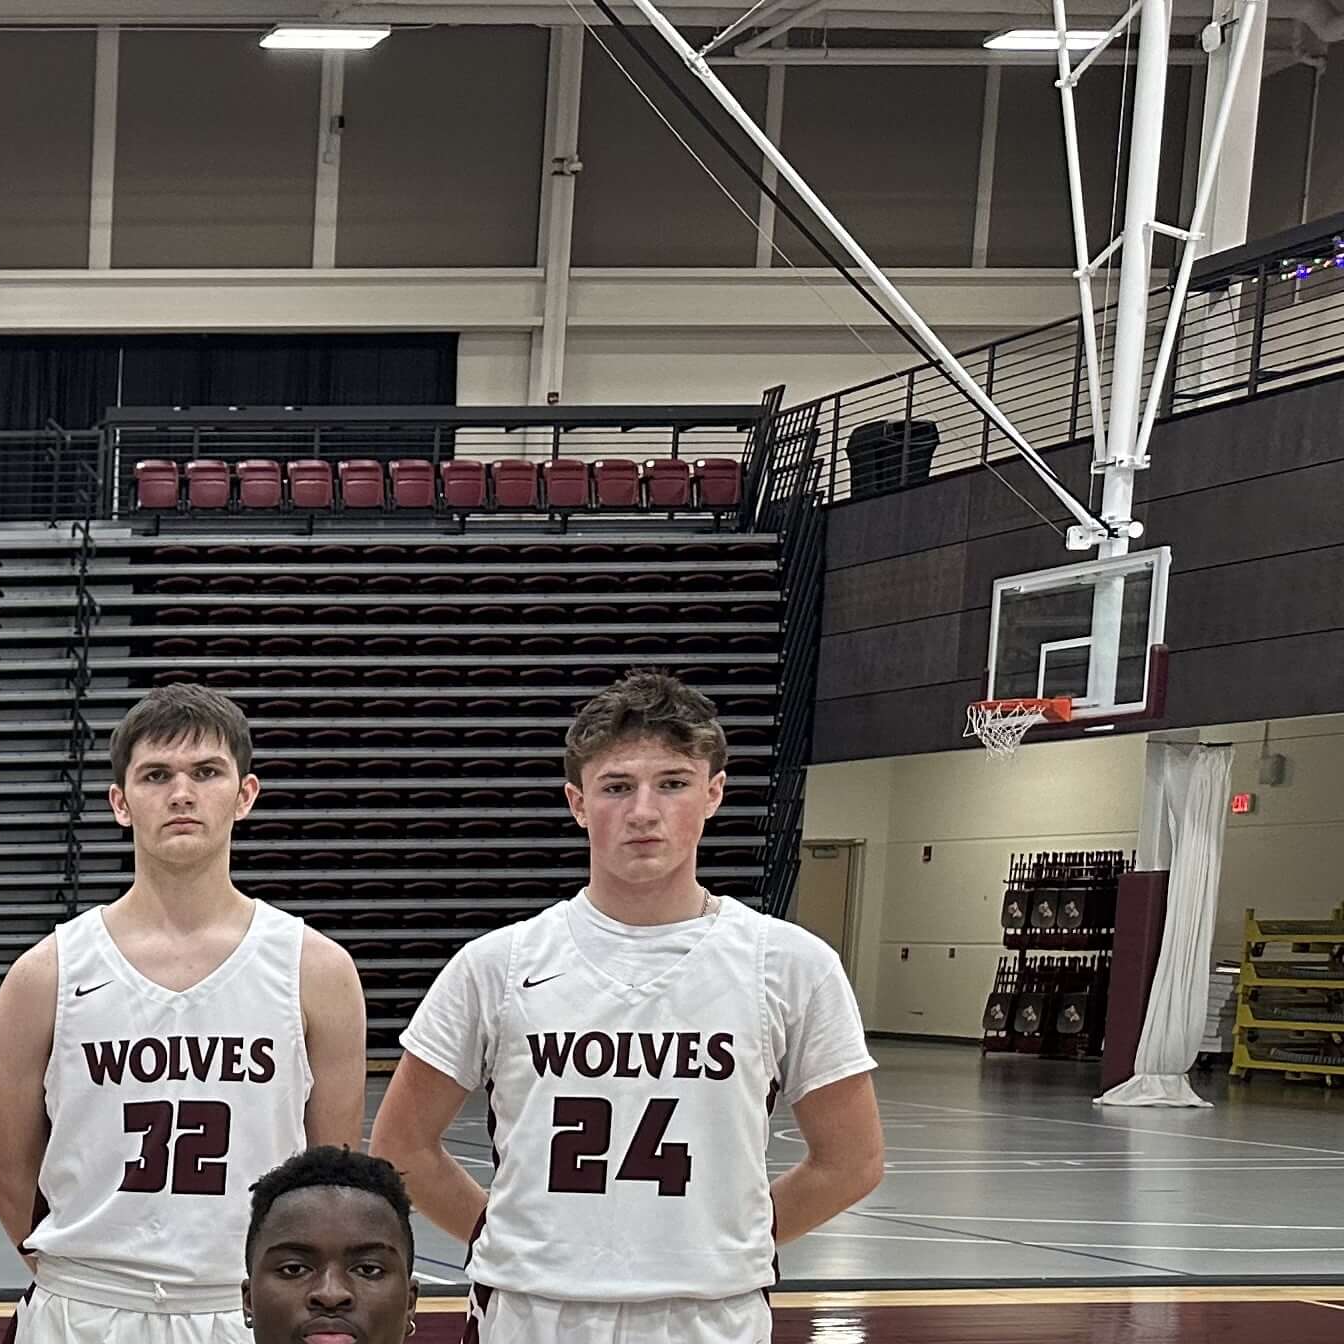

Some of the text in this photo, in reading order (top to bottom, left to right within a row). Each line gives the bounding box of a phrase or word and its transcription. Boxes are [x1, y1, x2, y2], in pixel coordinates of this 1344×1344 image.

[80, 1035, 276, 1087] WOLVES
[525, 1031, 736, 1081] WOLVES
[116, 1099, 232, 1196] 32
[547, 1096, 692, 1197] 24
